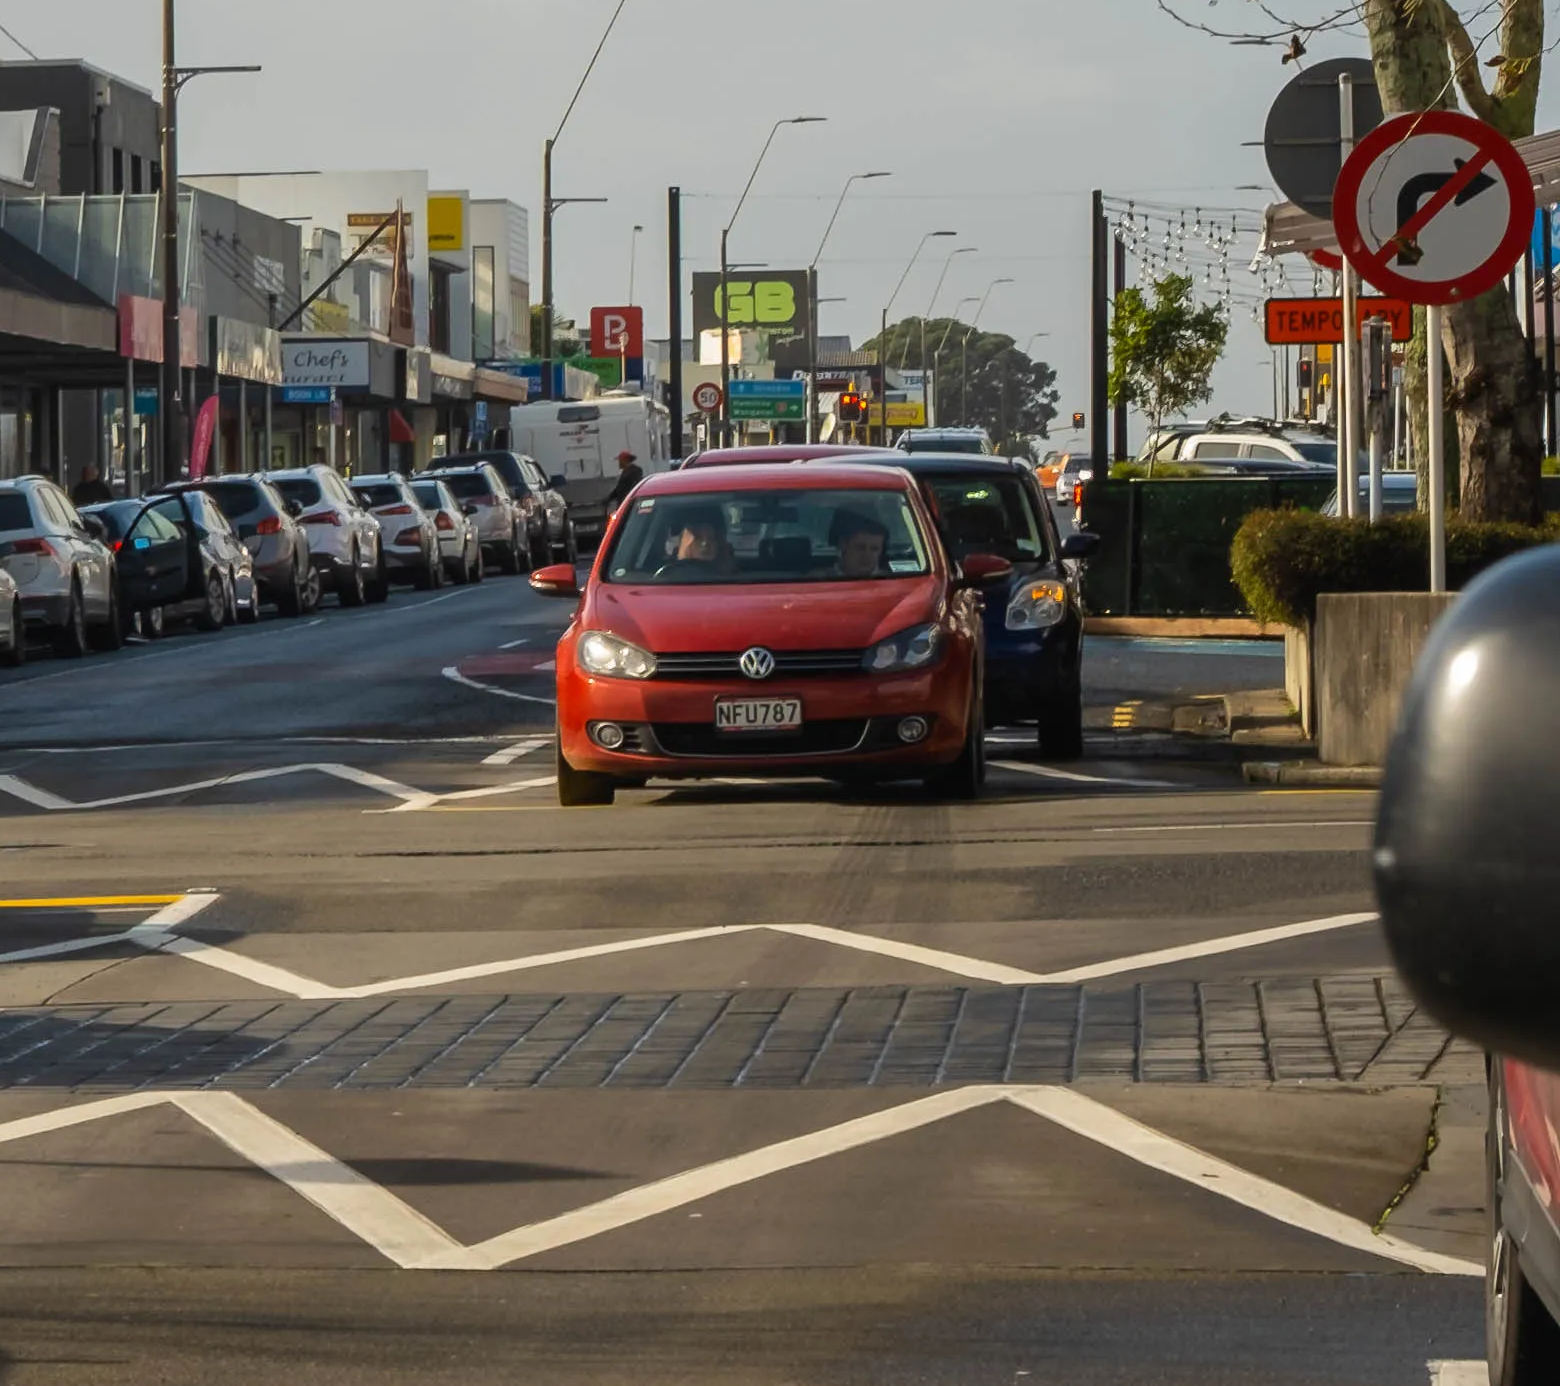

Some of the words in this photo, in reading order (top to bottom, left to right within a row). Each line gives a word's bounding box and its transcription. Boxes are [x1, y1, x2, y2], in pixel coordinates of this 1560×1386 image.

[714, 280, 796, 324] GB
[293, 348, 350, 370] Chef's
[716, 699, 802, 729] NFU787
